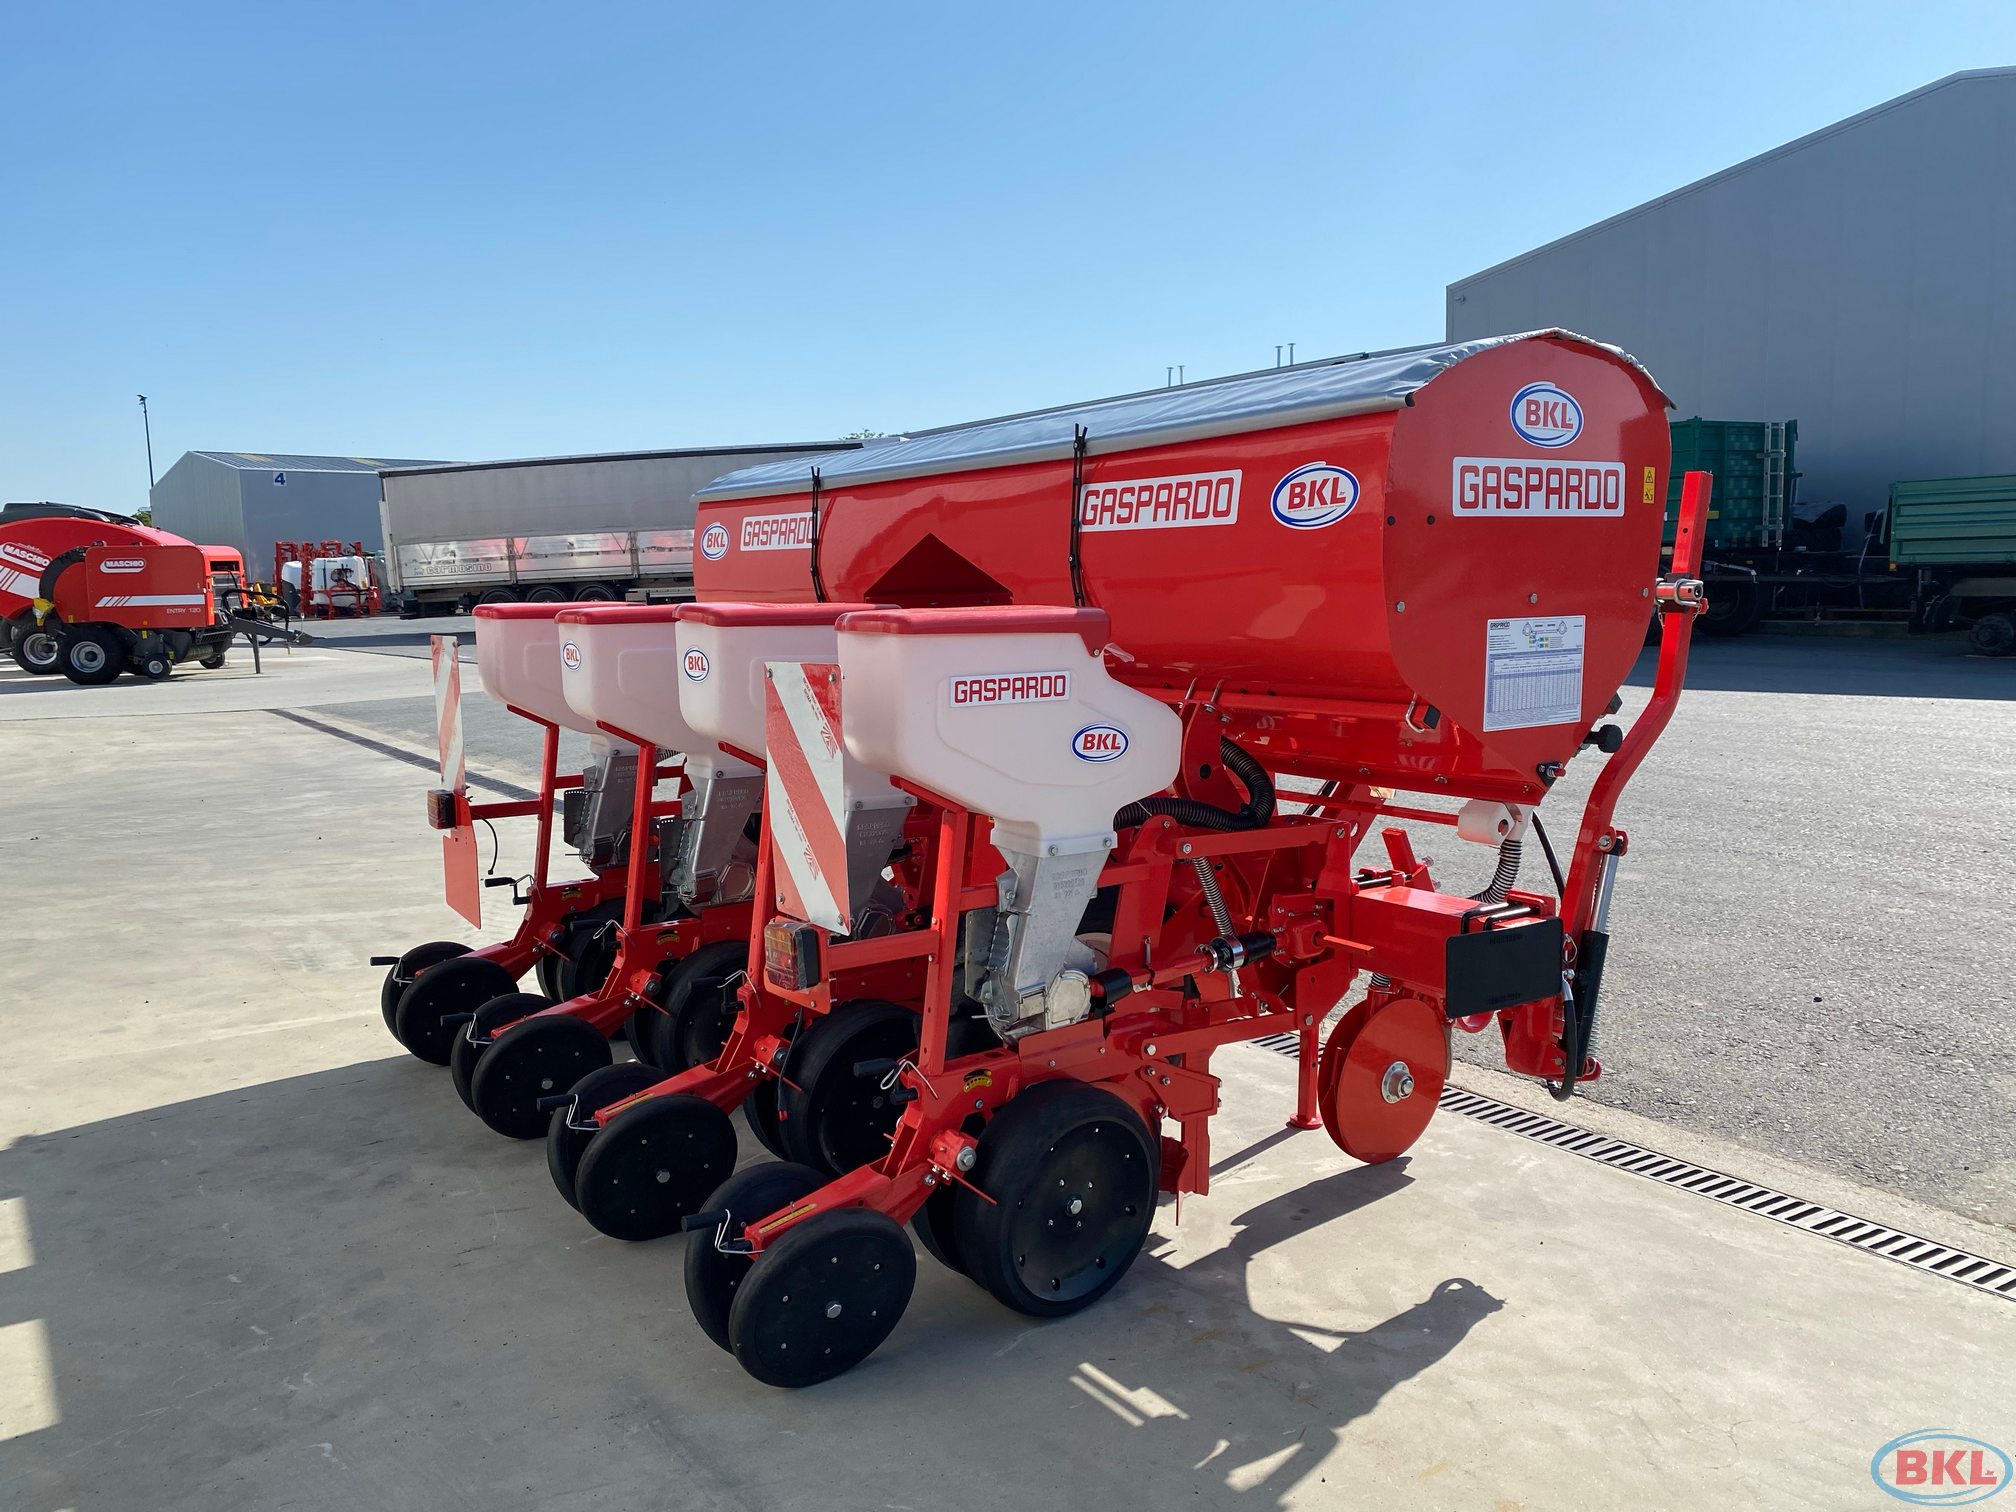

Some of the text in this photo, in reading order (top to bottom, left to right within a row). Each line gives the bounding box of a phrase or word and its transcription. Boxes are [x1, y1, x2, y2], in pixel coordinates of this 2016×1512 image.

[1525, 398, 1574, 430] BKL
[274, 472, 286, 485] 4
[1459, 465, 1620, 510] GASPARDO
[1081, 477, 1235, 526] GASPARDO
[1287, 476, 1347, 510] BKL
[706, 532, 726, 549] BKL
[4, 544, 50, 567] MASCHIO
[105, 560, 144, 568] MASCHIO
[565, 647, 580, 662] BKL
[687, 655, 707, 672] BKL
[954, 674, 1067, 704] GASPARDO
[1082, 733, 1122, 751] BKL
